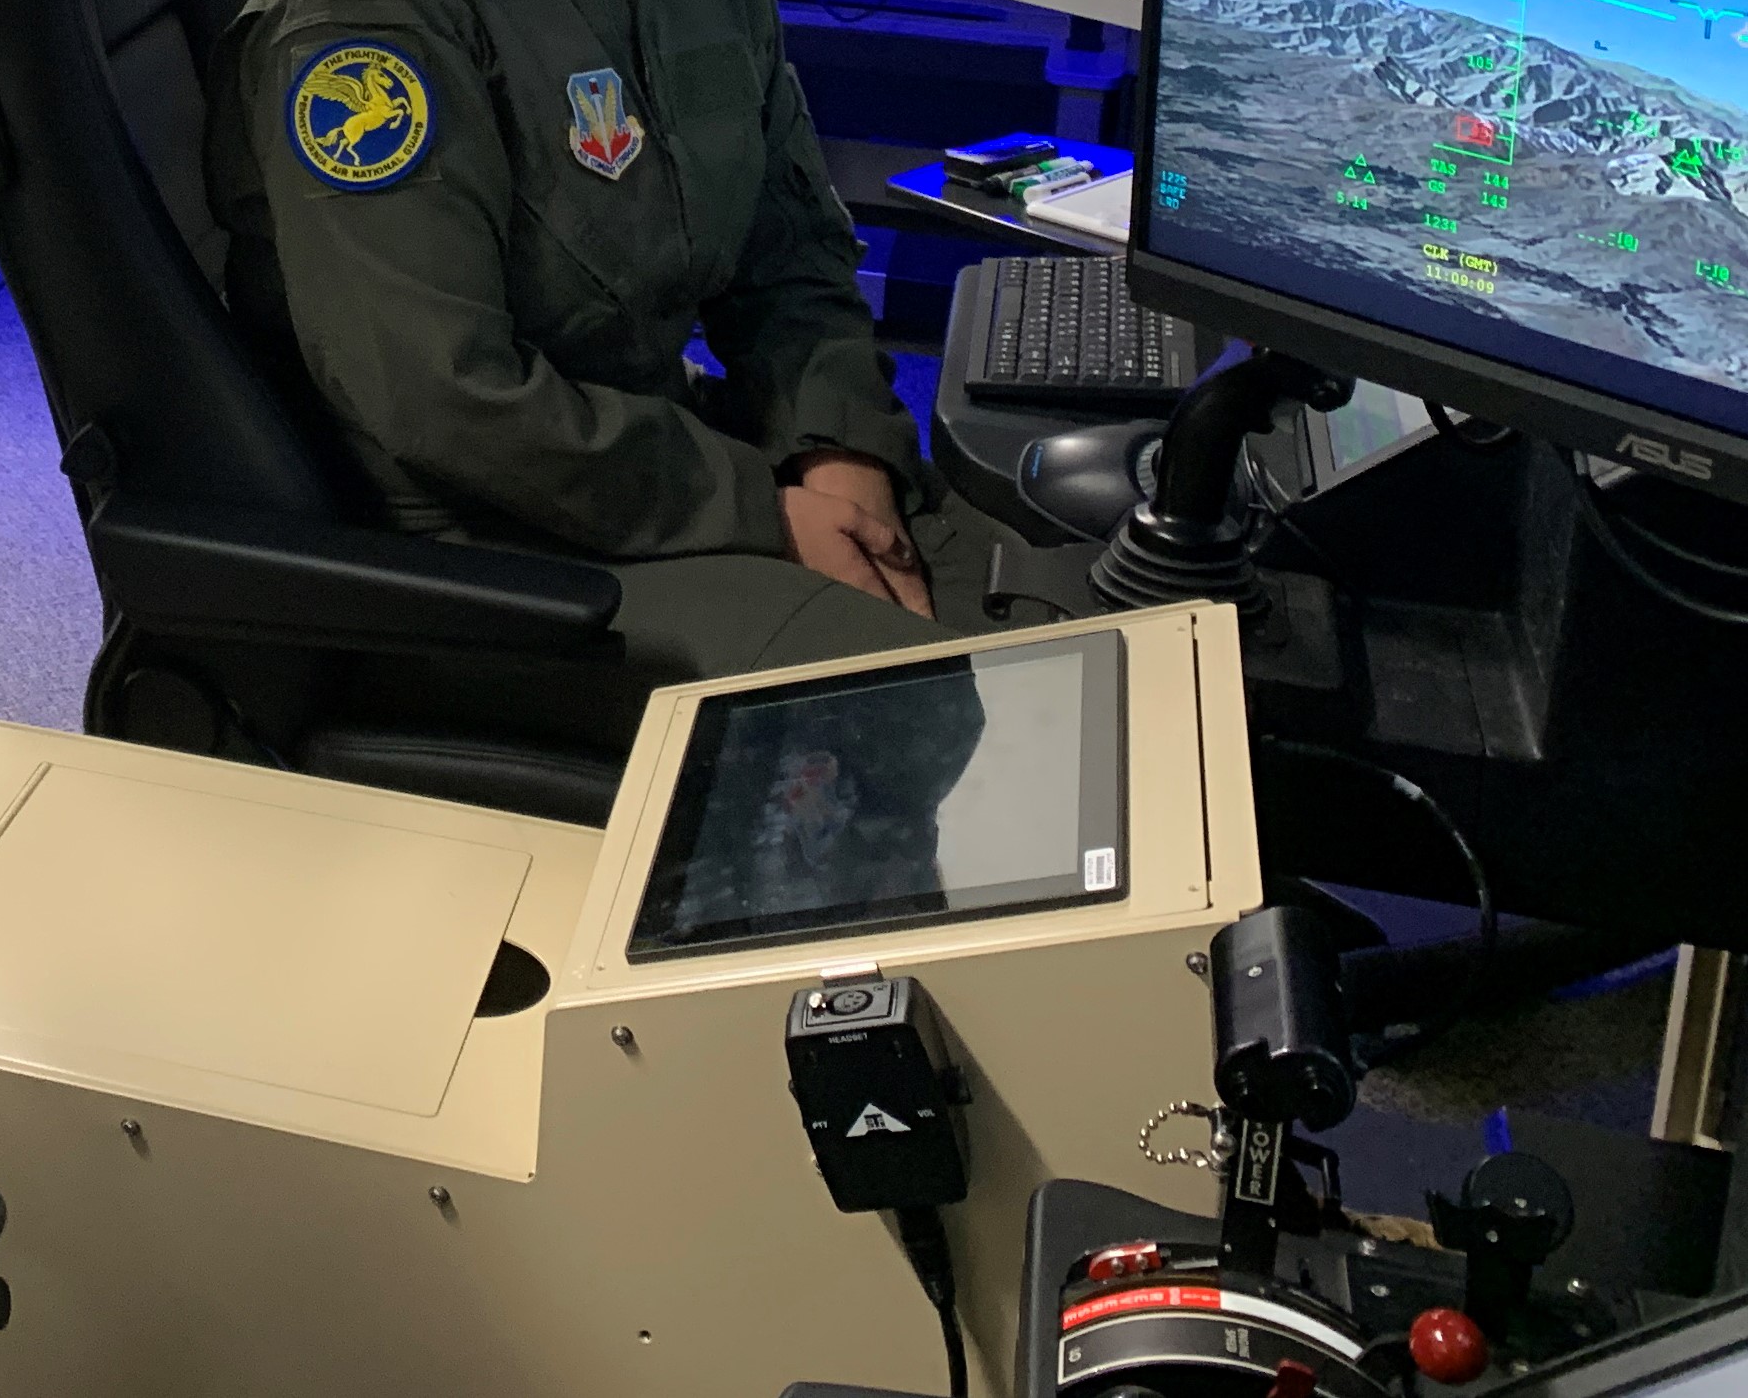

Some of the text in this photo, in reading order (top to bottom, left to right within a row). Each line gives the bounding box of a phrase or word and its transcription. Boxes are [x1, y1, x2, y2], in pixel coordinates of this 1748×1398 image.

[330, 165, 349, 177] AIR
[352, 157, 405, 178] NATIONAL
[1430, 158, 1510, 190] TAS 144
[1481, 192, 1508, 210] 143
[1423, 243, 1499, 277] CLK (GMT)
[1426, 264, 1495, 294] 11:09:09
[1615, 433, 1713, 480] ASUS
[828, 1032, 869, 1044] HEADSET
[917, 1109, 936, 1118] VOL
[1249, 1122, 1272, 1197] OWER
